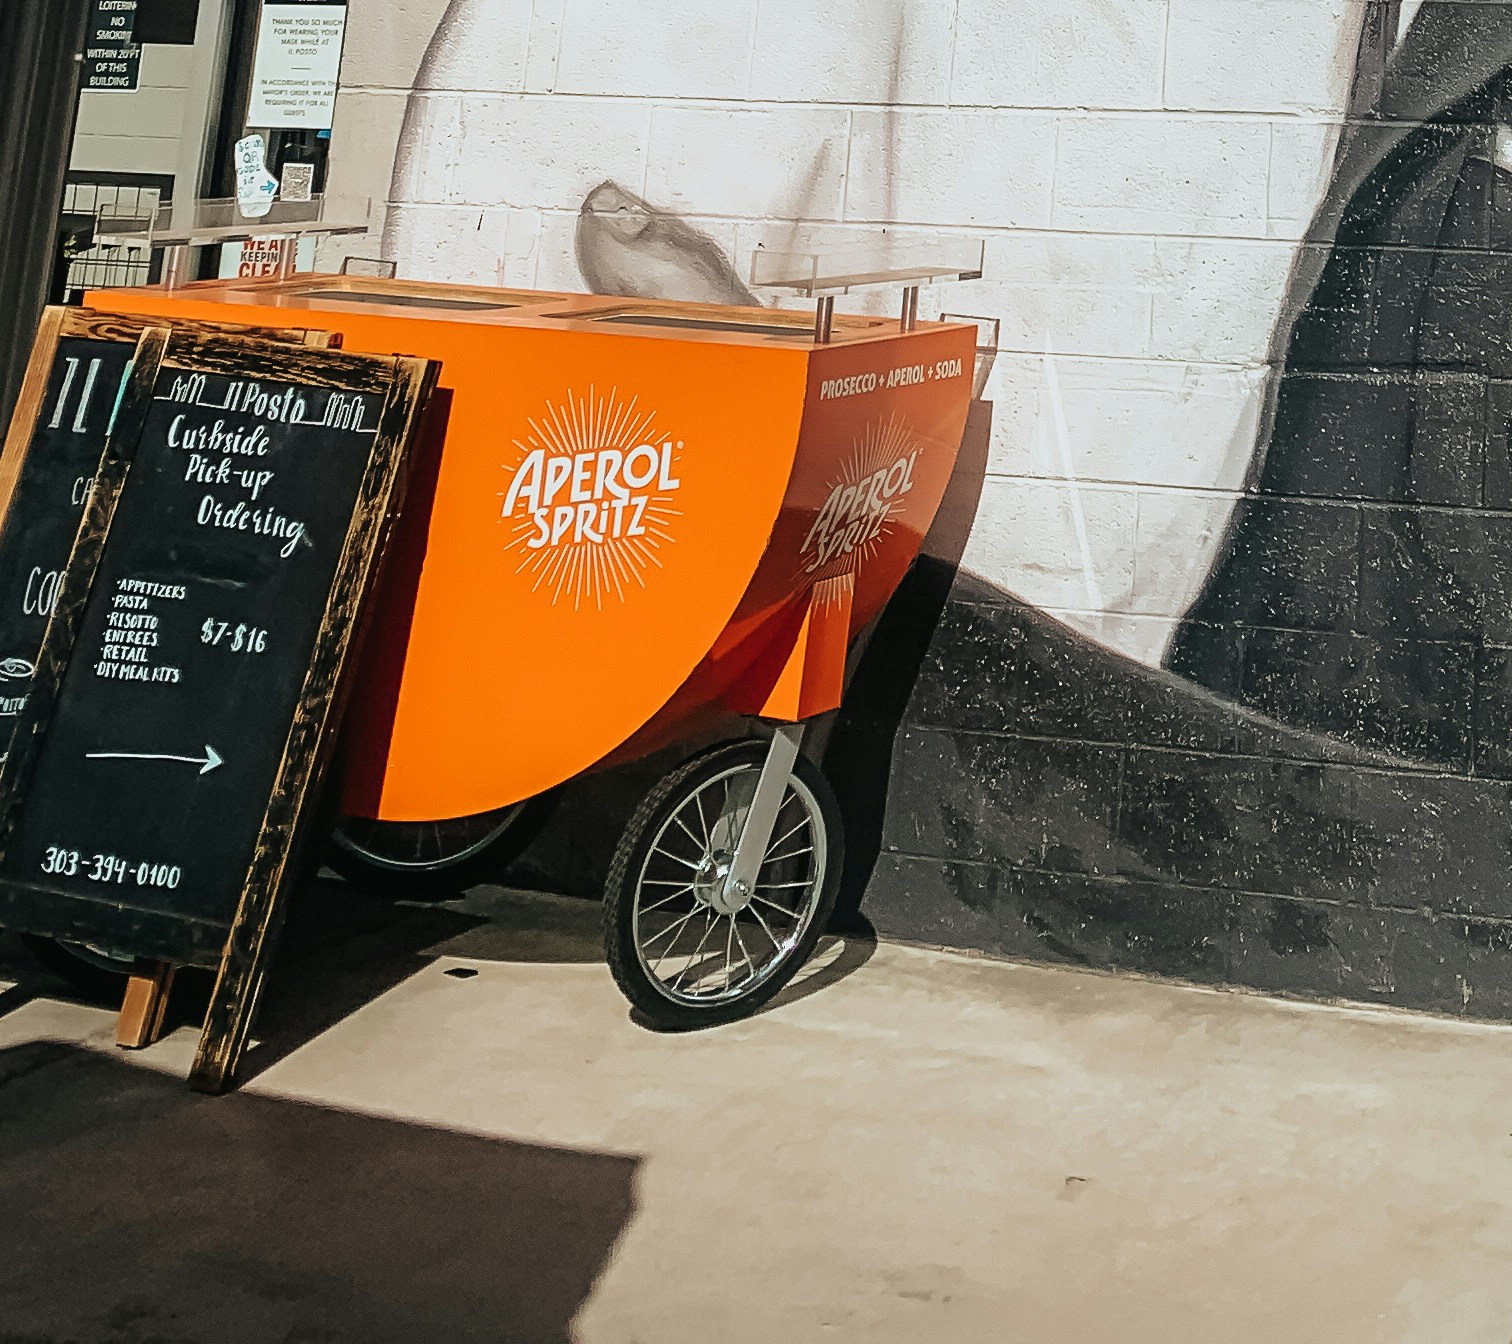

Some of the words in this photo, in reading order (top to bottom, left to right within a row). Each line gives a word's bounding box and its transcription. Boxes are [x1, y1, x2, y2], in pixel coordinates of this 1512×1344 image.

[110, 16, 126, 26] NO
[272, 18, 293, 26] THANK
[96, 30, 133, 40] SMOKIN
[300, 38, 320, 46] WHILE
[87, 48, 118, 59] WITHIN
[295, 48, 318, 56] POSTO
[96, 62, 108, 72] OF
[108, 62, 127, 72] THIS
[90, 76, 130, 86] BUILDING
[243, 240, 266, 251] WE
[240, 251, 280, 262] KEEPIN
[820, 372, 876, 400] PROSECCO
[886, 364, 925, 389] APEROL
[934, 358, 962, 380] SODA
[240, 382, 306, 424] Posto
[168, 414, 270, 456] Curbside
[184, 454, 275, 501] Pick-up
[501, 441, 681, 518] APEROL
[800, 450, 918, 554] APEROL
[197, 494, 305, 559] Ordering
[118, 578, 187, 600] APPETIZERS
[114, 594, 149, 610] PASTA
[109, 612, 159, 630] RISOTTO
[104, 628, 158, 647] ENTREES
[200, 617, 268, 654] $7-$16
[102, 644, 149, 662] RETAIL
[96, 660, 119, 679] DIY
[118, 664, 150, 682] MEAL
[152, 666, 182, 684] KITS
[40, 846, 182, 889] 303-394-0100
